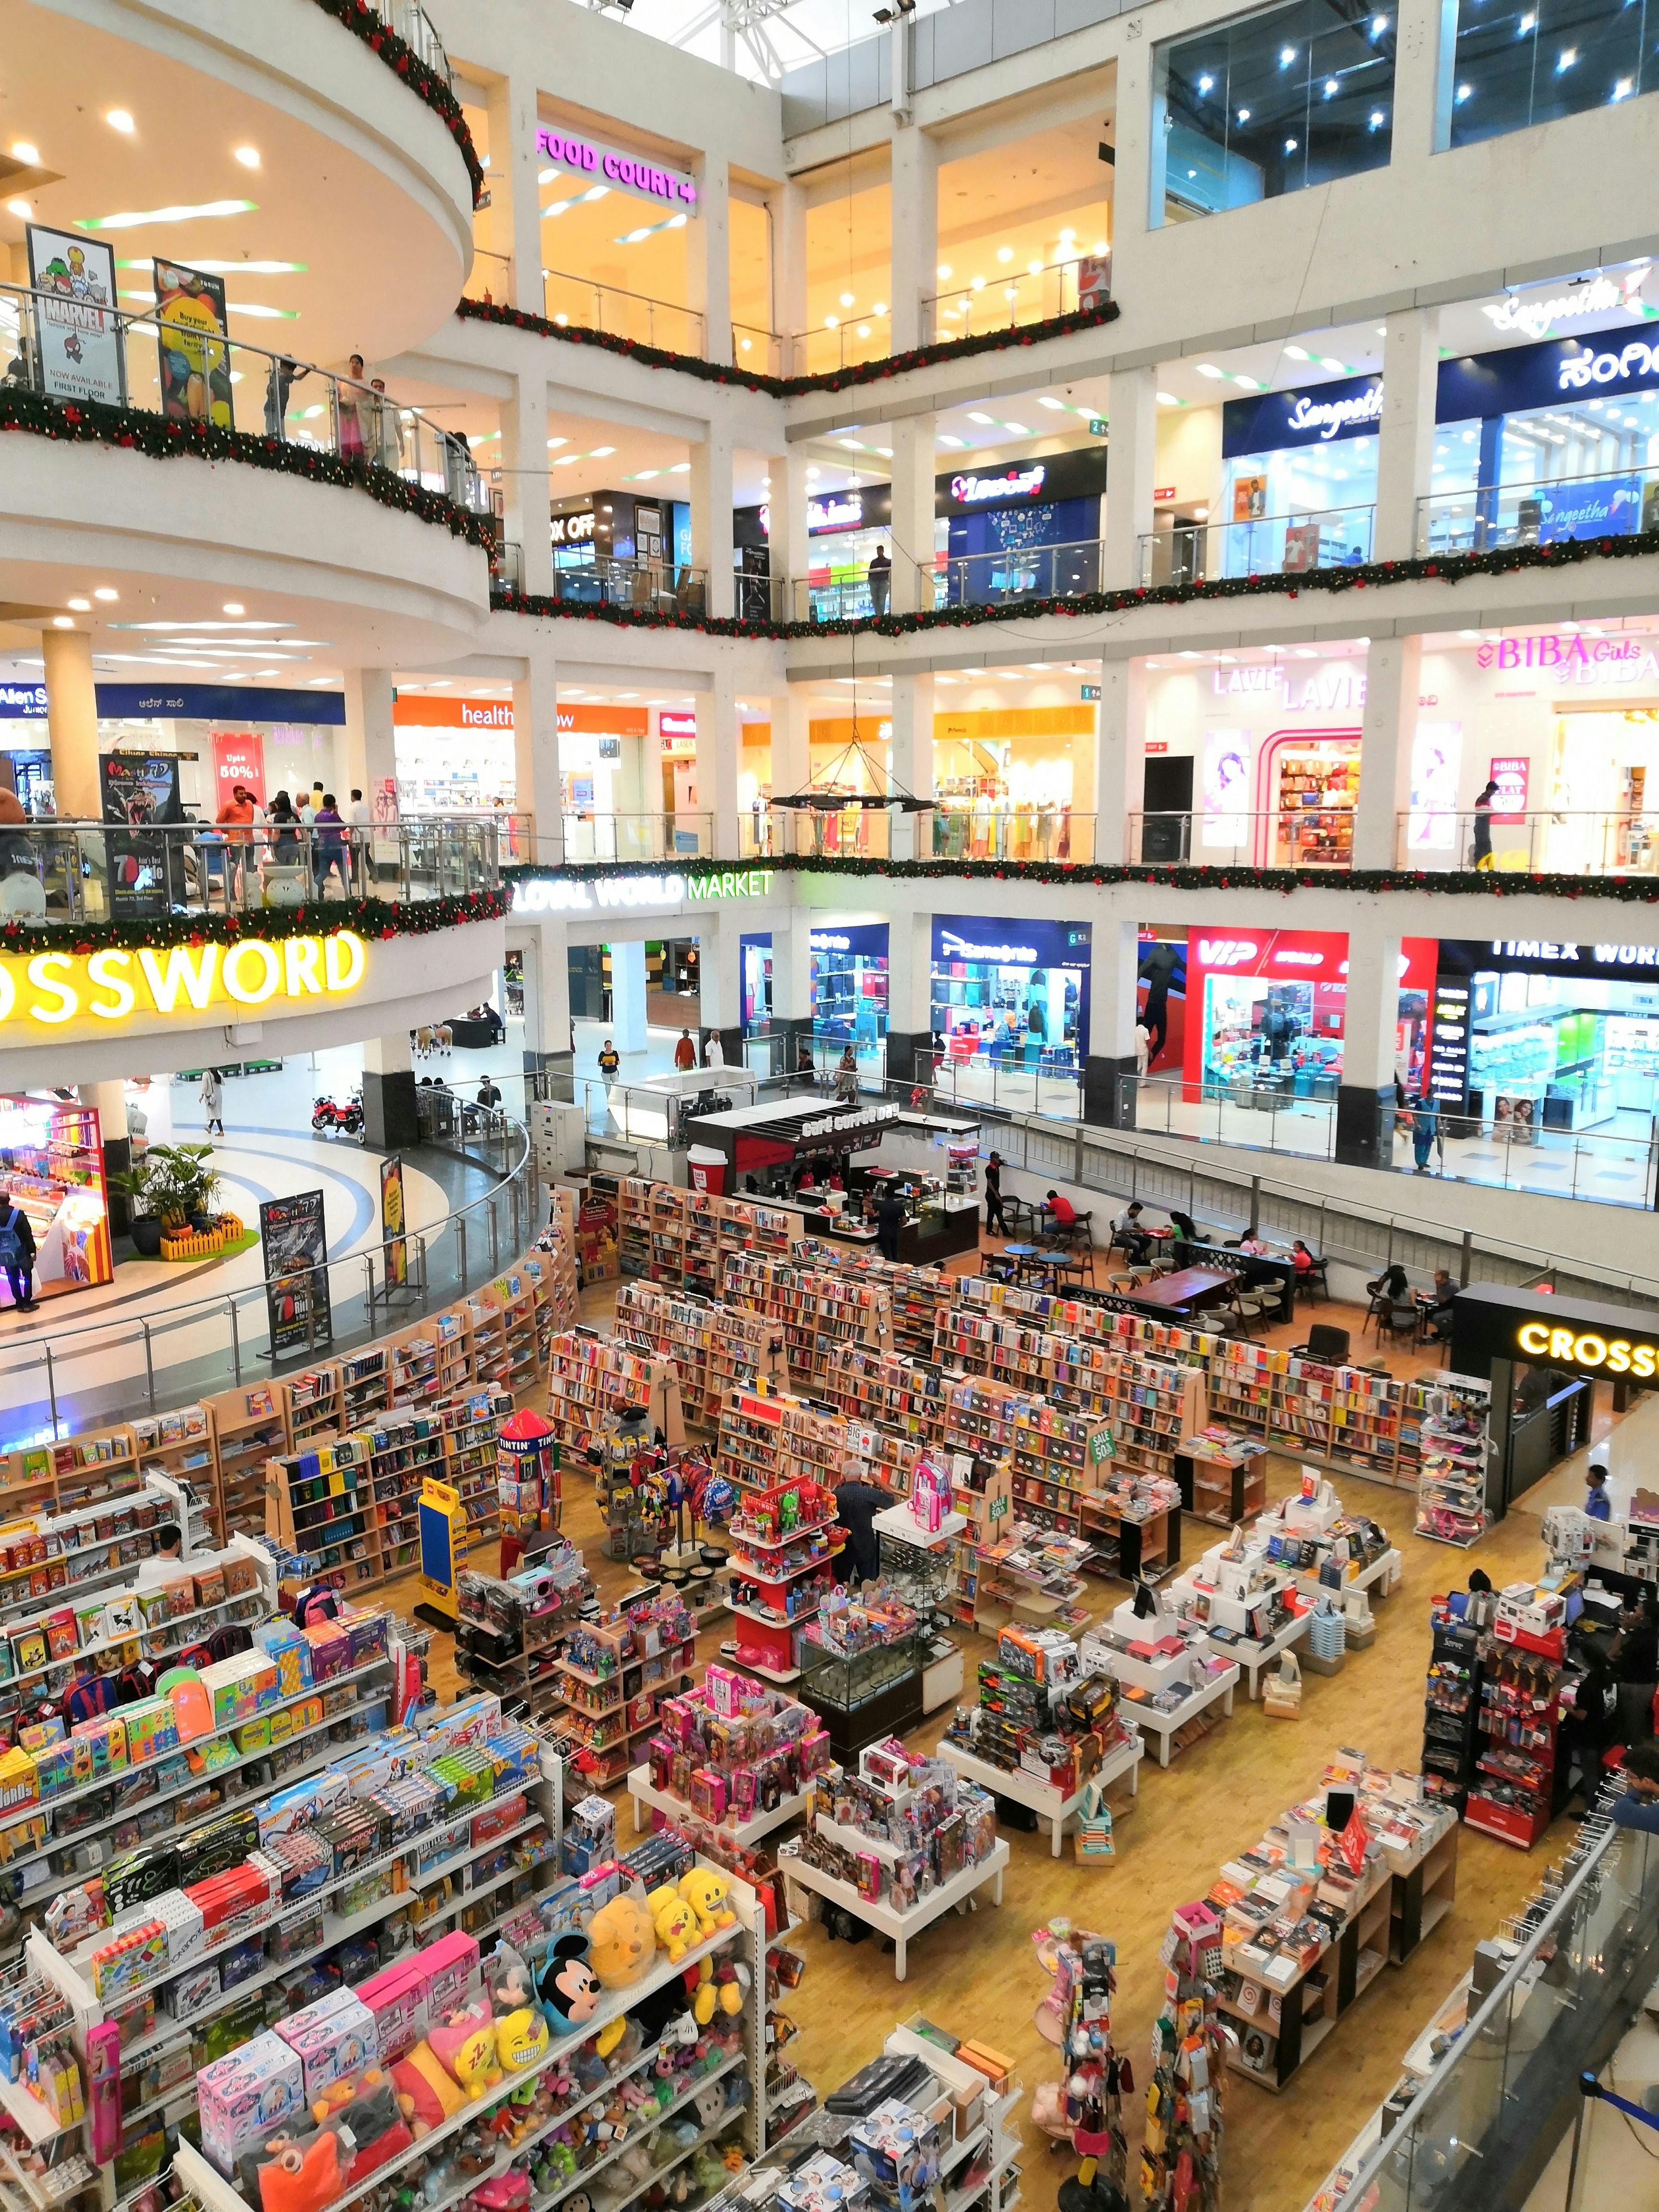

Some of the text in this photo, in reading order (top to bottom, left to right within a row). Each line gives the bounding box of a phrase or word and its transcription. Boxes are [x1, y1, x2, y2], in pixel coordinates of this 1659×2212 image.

[536, 127, 677, 200] FOOD COURT
[179, 311, 208, 326] Buy your
[50, 369, 113, 389] NOW AVAILABLE
[53, 381, 106, 399] FIRST FLOOR
[1093, 421, 1099, 432] 2
[567, 514, 595, 539] OFF
[1498, 634, 1641, 669] BIBA Girls
[1214, 666, 1285, 695] LAVIE
[35, 688, 48, 704] S
[1283, 673, 1367, 711] LAVIE
[462, 703, 515, 726] health
[226, 754, 246, 763] Upto
[220, 765, 253, 779] 50%
[113, 854, 138, 882] 7D
[594, 874, 685, 906] WORLD
[687, 870, 775, 900] MARKET
[1070, 934, 1076, 946] G
[1200, 939, 1258, 965] VIP
[1594, 944, 1659, 965] WOR
[0, 930, 366, 1023] SSWORD
[275, 1295, 295, 1322] 7D
[1518, 1322, 1659, 1378] CROSS
[848, 1425, 860, 1439] BIG
[1093, 1430, 1110, 1447] SALE
[500, 1438, 528, 1451] TINTIN
[762, 1502, 774, 1512] HOP
[992, 1496, 1006, 1510] SALE
[156, 1713, 163, 1724] 2
[337, 1826, 377, 1851] MONOPOLY
[220, 1899, 256, 1920] MONOPOLY
